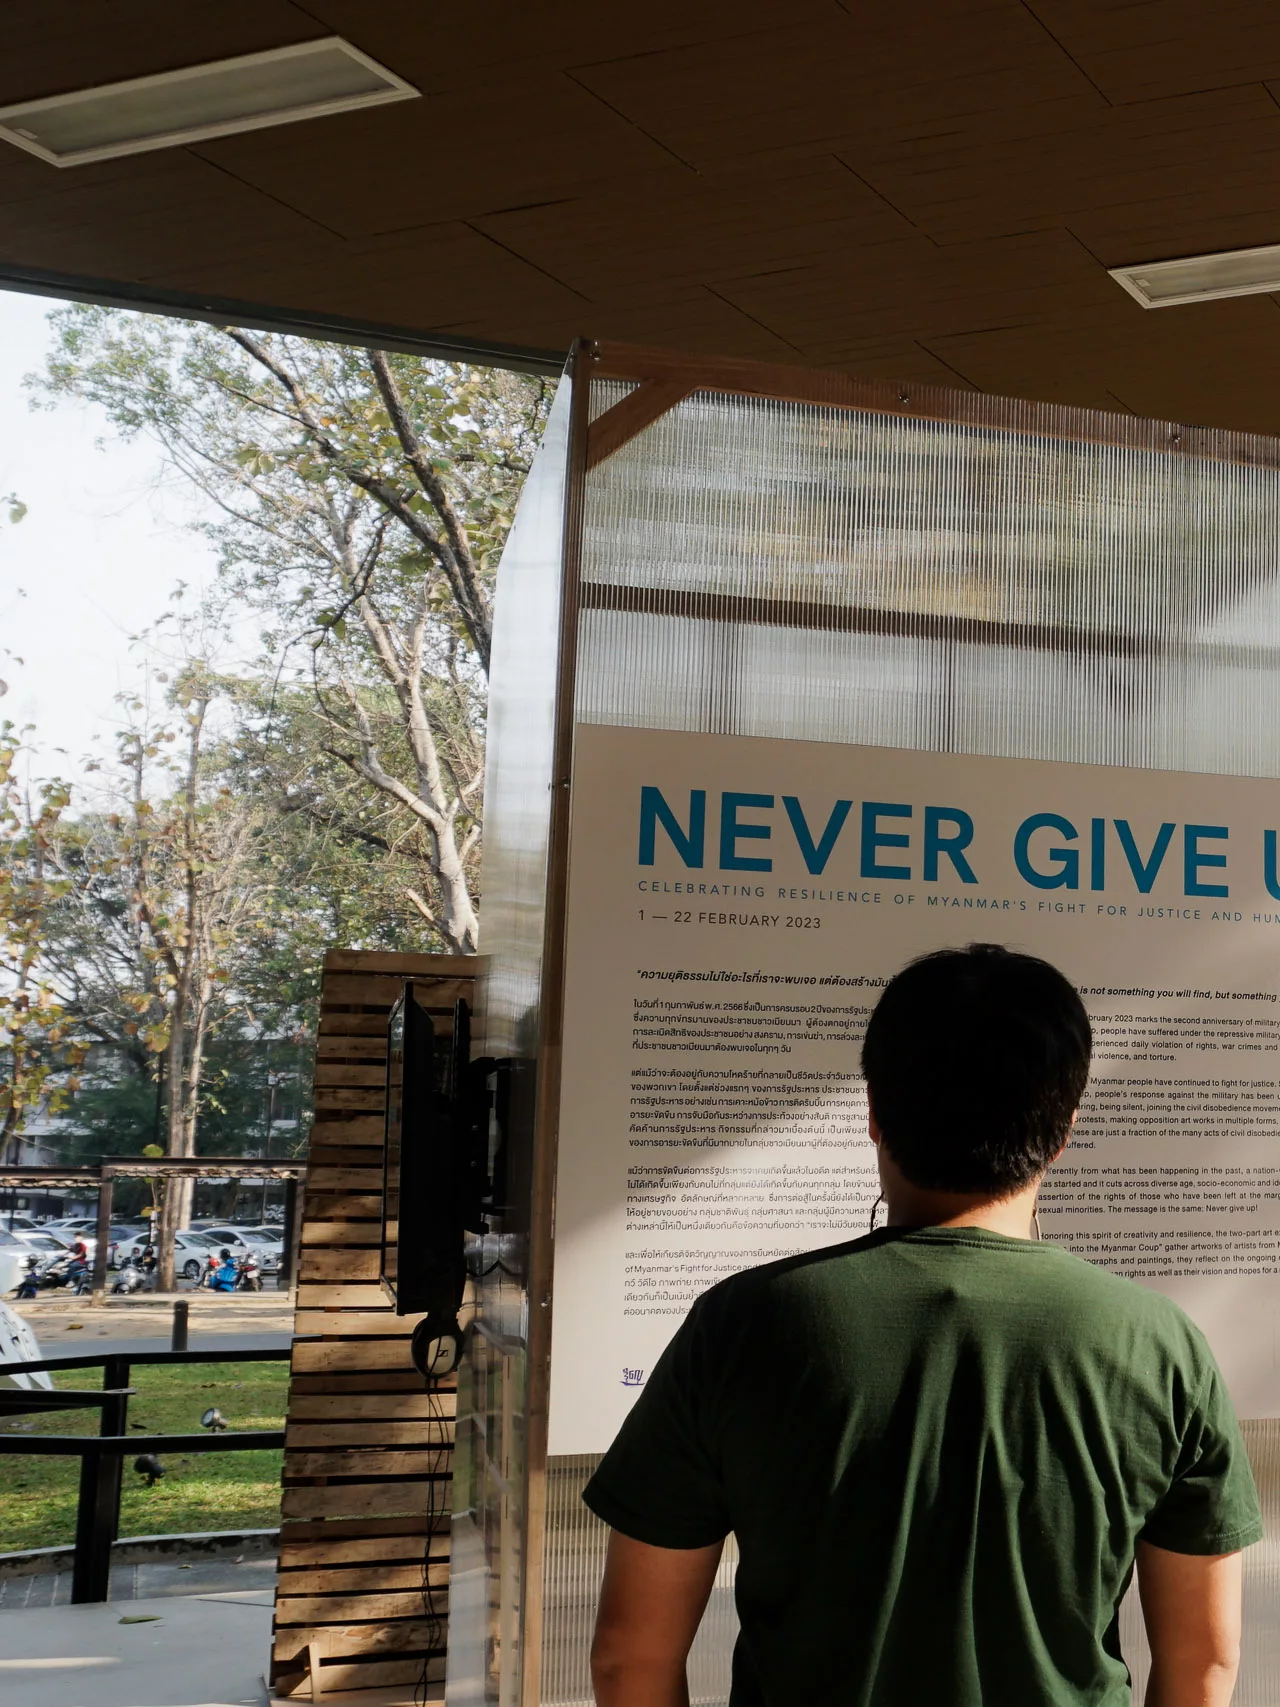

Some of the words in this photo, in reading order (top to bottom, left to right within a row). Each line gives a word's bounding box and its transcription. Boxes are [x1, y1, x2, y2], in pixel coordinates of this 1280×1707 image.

[639, 787, 976, 883] NEVER
[1014, 814, 1228, 897] GIVE
[638, 879, 764, 898] CELEBRATING
[778, 885, 881, 903] RESILIENCE
[894, 893, 914, 905] OF
[927, 895, 1026, 910] MYANMAR'S
[1038, 901, 1086, 913] FIGHT
[1097, 904, 1127, 916] FOR
[1138, 905, 1200, 919] JUSTICE
[1212, 910, 1242, 921] AND
[638, 909, 643, 920] 1
[674, 910, 691, 924] 22
[698, 910, 779, 927] FEBRUARY
[786, 915, 820, 929] 2023
[1080, 985, 1088, 994] is
[1089, 986, 1106, 994] not
[1107, 986, 1155, 998] something
[1158, 990, 1174, 999] you
[1176, 989, 1192, 997] will
[1193, 989, 1213, 999] find,
[1215, 990, 1230, 999] but
[1231, 991, 1277, 1002] something
[1089, 1013, 1112, 1023] bruary
[1115, 1014, 1133, 1022] 2023
[1160, 1015, 1172, 1023] the
[1173, 1016, 1200, 1024] second
[1202, 1016, 1244, 1027] anniversary
[1255, 1018, 1280, 1028] military
[1101, 1026, 1126, 1036] people
[1128, 1027, 1146, 1035] have
[1148, 1028, 1179, 1036] suffered
[1180, 1028, 1202, 1036] under
[1217, 1029, 1254, 1039] repressive
[1091, 1077, 1125, 1086] Myanmar
[1127, 1077, 1153, 1087] people
[1174, 1078, 1210, 1086] continued
[1221, 1079, 1237, 1088] fight
[1251, 1079, 1276, 1089] justice.
[1088, 1192, 1101, 1200] the
[1104, 1192, 1126, 1201] rights
[1203, 1191, 1221, 1199] been
[1225, 1191, 1236, 1199] left
[1065, 1205, 1105, 1213] minorities.
[1124, 1206, 1158, 1214] message
[1168, 1204, 1180, 1212] the
[1229, 1204, 1244, 1213] give
[1246, 1204, 1257, 1213] up!
[1069, 1244, 1084, 1252] into
[1086, 1244, 1099, 1252] the
[1101, 1243, 1136, 1253] Myanmar
[1165, 1242, 1188, 1252] gather
[1191, 1242, 1222, 1250] artworks
[1234, 1241, 1256, 1249] artists
[681, 1265, 700, 1273] Fight
[713, 1264, 741, 1272] Justice
